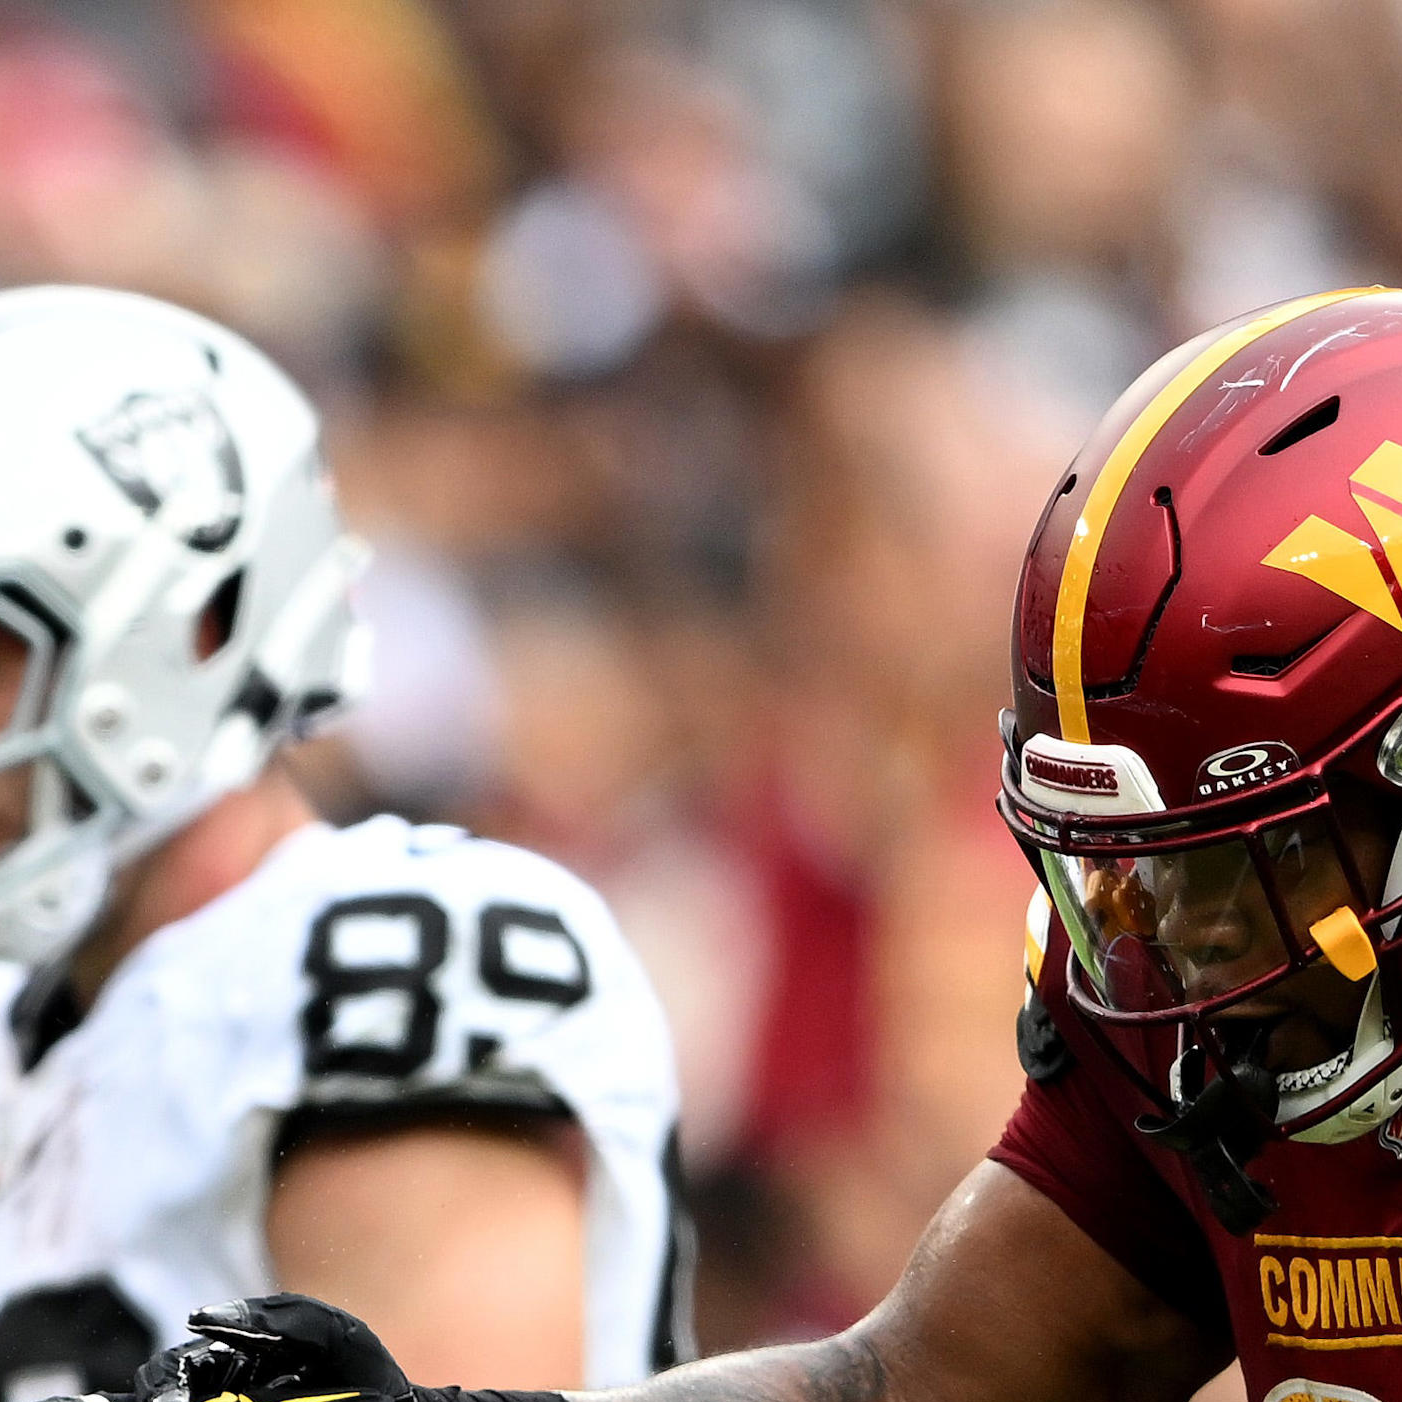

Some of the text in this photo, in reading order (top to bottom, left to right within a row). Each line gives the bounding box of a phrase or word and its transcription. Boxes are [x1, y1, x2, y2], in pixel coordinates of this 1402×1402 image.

[1025, 754, 1118, 790] COMMANDERS
[1199, 759, 1290, 796] OAKLEY
[301, 893, 592, 1079] 89
